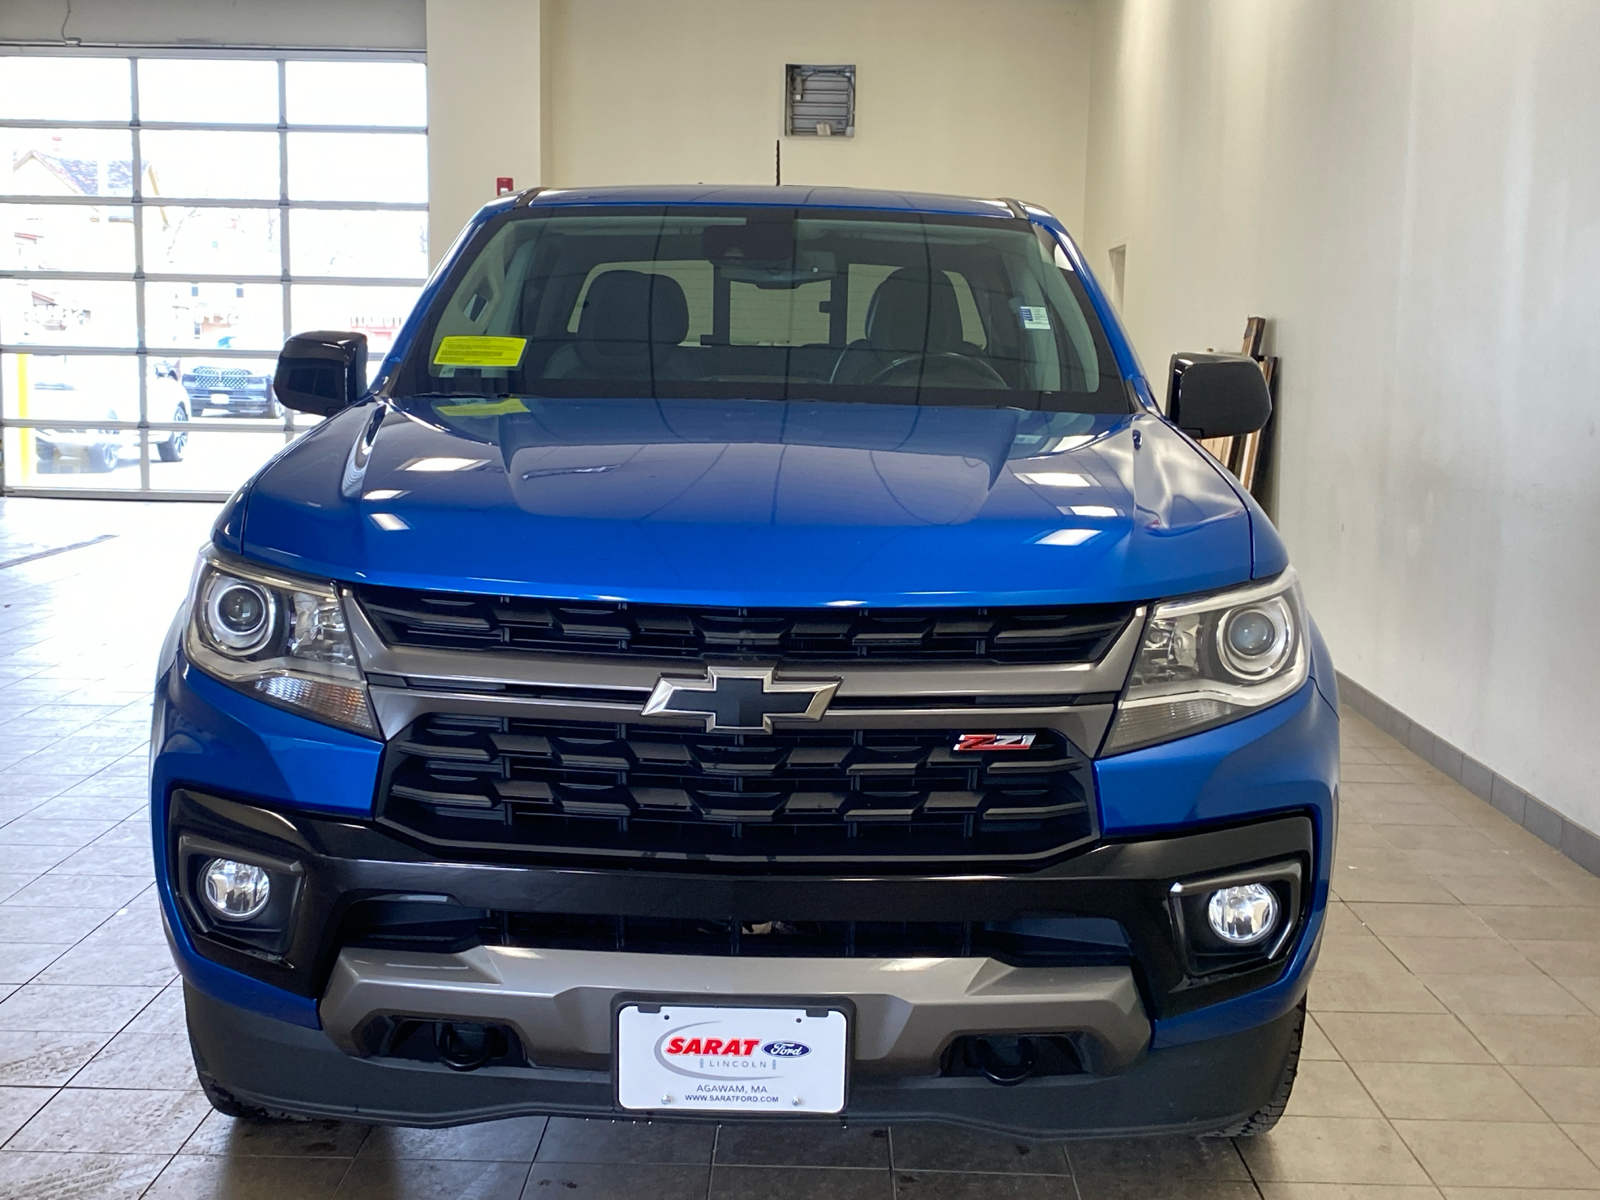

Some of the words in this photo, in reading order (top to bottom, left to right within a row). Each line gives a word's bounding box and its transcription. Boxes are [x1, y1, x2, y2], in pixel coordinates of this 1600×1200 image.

[953, 734, 1036, 750] Z71
[666, 1036, 761, 1056] SARAT
[770, 1043, 802, 1056] Ford
[709, 1060, 767, 1068] LINCOLN
[696, 1084, 748, 1094] AGAWAM,
[751, 1085, 768, 1093] MA
[685, 1094, 779, 1103] WWW.SARATFORD.COM
